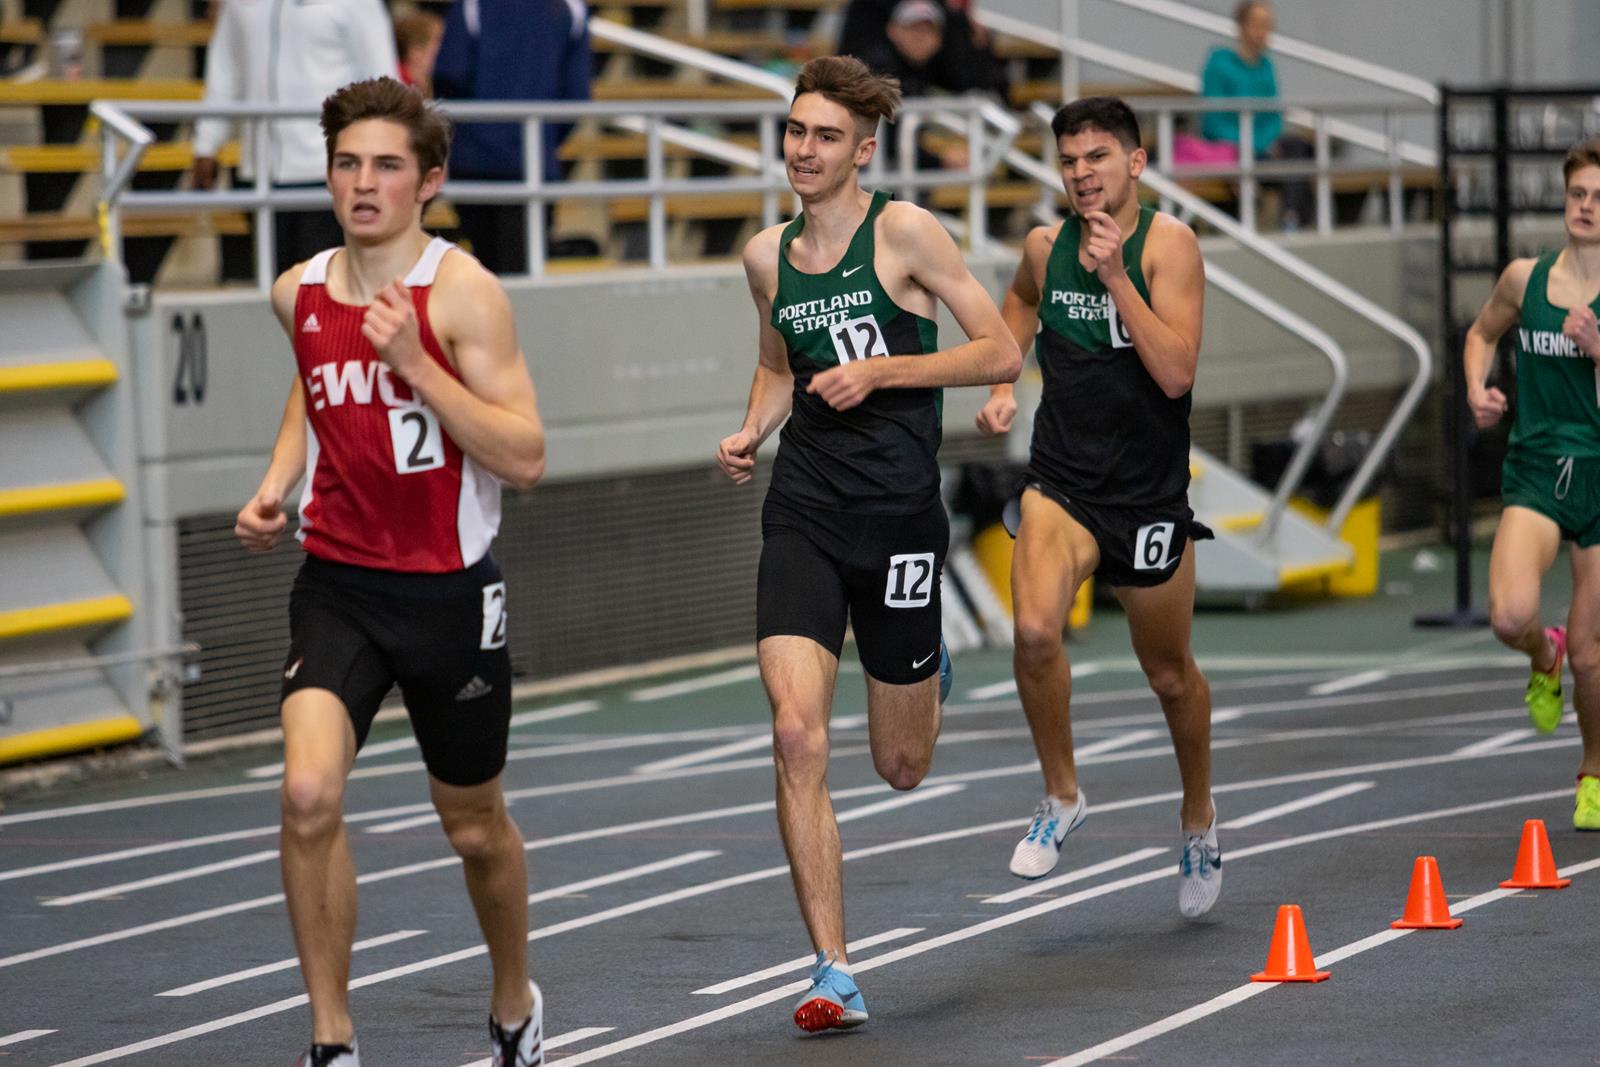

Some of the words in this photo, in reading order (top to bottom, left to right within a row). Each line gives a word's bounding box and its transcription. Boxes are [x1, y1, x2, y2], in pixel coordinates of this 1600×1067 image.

[779, 290, 872, 323] PORTLAND
[793, 309, 851, 334] STATE
[171, 312, 208, 405] 20
[836, 322, 886, 361] 12
[401, 411, 434, 467] 2
[1144, 525, 1166, 567] 6
[890, 559, 930, 601] 12
